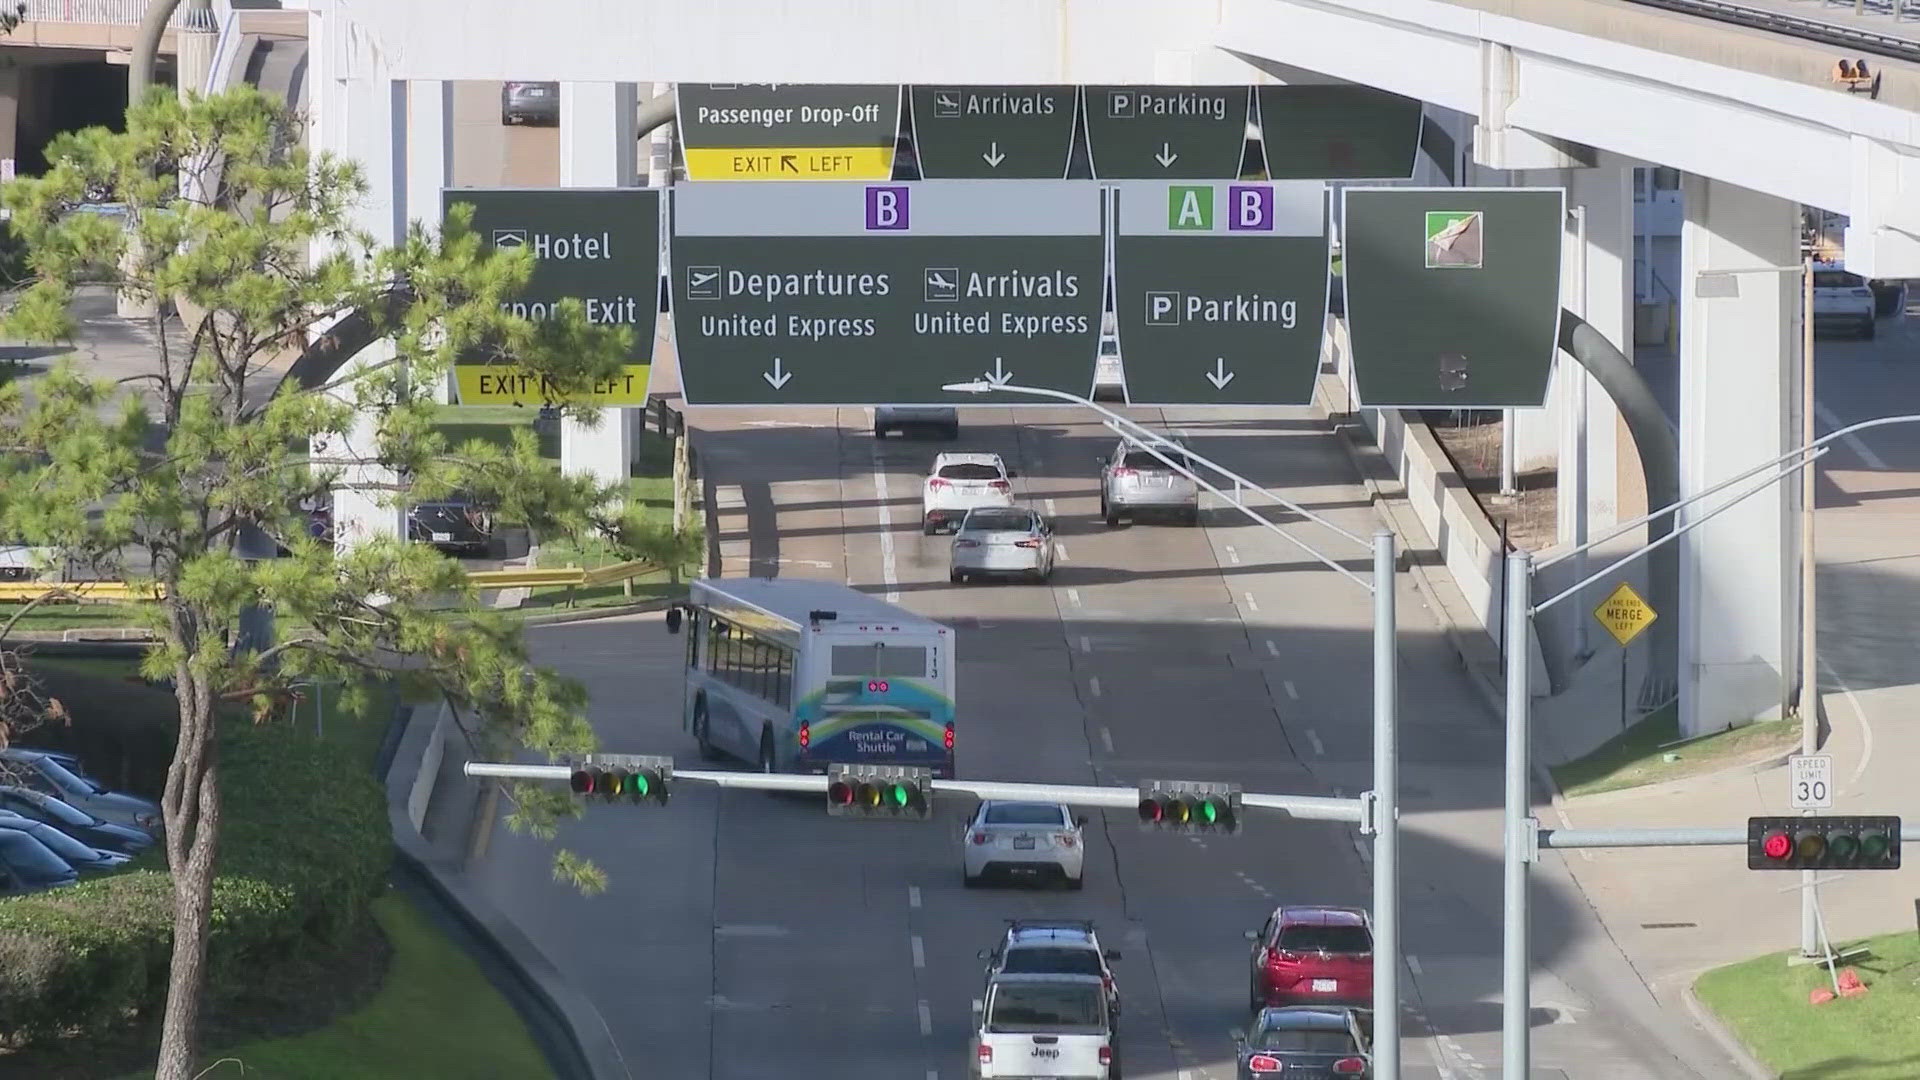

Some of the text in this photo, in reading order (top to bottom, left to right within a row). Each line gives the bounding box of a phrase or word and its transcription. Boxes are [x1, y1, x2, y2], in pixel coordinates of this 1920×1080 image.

[966, 93, 1055, 115] Arrivals
[1139, 93, 1226, 120] Parking
[698, 104, 880, 127] Passenger Drop-Off
[733, 156, 853, 172] EXIT LEFT
[876, 190, 899, 227] B
[1178, 190, 1263, 227] A B
[534, 232, 611, 259] Hotel
[728, 269, 891, 303] Departures
[966, 269, 1079, 298] Arrivals
[586, 296, 637, 324] Exit
[1186, 293, 1297, 329] Parking
[701, 314, 876, 342] United Express
[914, 311, 1088, 339] United Express
[480, 375, 531, 395] EXIT
[594, 375, 635, 395] EFT
[1607, 609, 1642, 620] MERGE
[1615, 622, 1633, 630] LEFT
[848, 730, 905, 741] Rental Car
[856, 741, 897, 752] Shuttle
[1797, 760, 1826, 768] SPEED
[1800, 771, 1821, 779] LIMIT
[1798, 781, 1826, 801] 30
[1030, 1047, 1060, 1059] Jeep
